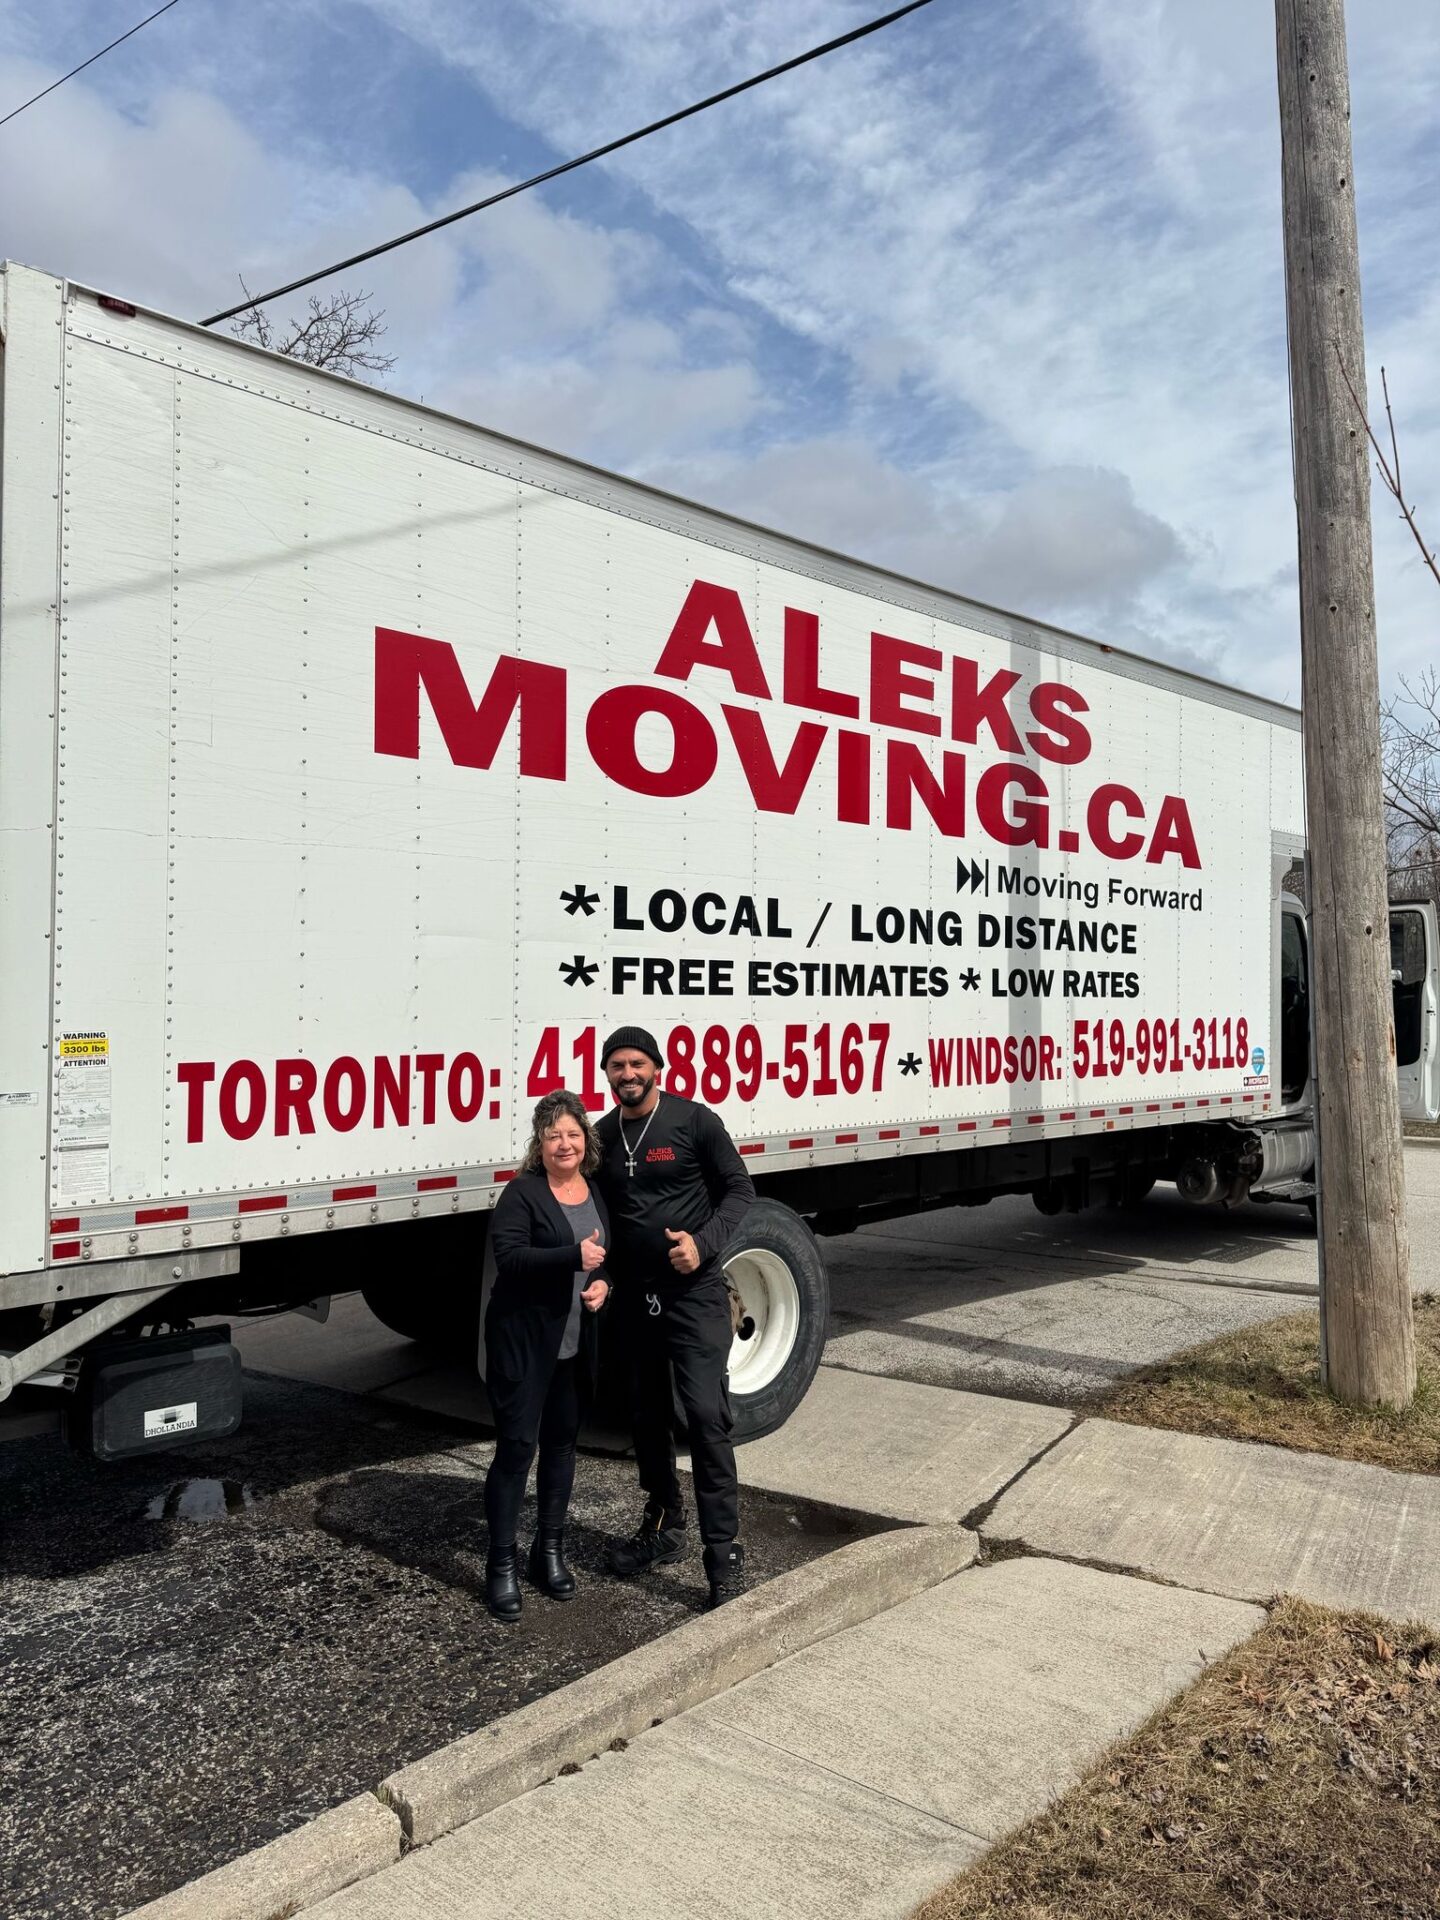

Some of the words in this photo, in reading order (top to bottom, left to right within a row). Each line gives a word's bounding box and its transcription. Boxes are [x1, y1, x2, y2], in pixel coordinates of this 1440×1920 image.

[654, 579, 1092, 765] ALEKS
[374, 625, 1202, 869] MOVING.CA
[997, 865, 1098, 909] Moving
[1108, 878, 1202, 911] Forward
[613, 885, 792, 939] LOCAL
[851, 904, 962, 947] LONG
[978, 913, 1137, 954] DISTANCE
[612, 956, 734, 996] FREE
[748, 960, 949, 997] ESTIMATES
[991, 968, 1054, 998] LOW
[1063, 969, 1139, 998] RATES
[63, 1032, 106, 1040] WARNING
[64, 1045, 88, 1053] 3300
[63, 1059, 106, 1067] ATTENTION
[177, 1051, 501, 1144] TORONTO:
[526, 1022, 890, 1112] 41889-5167
[928, 1035, 1062, 1088] WINDSOR:
[1073, 1016, 1248, 1079] 519-991-3118
[648, 1147, 672, 1155] ALEKS
[145, 1421, 195, 1436] DHOLLANDIA
